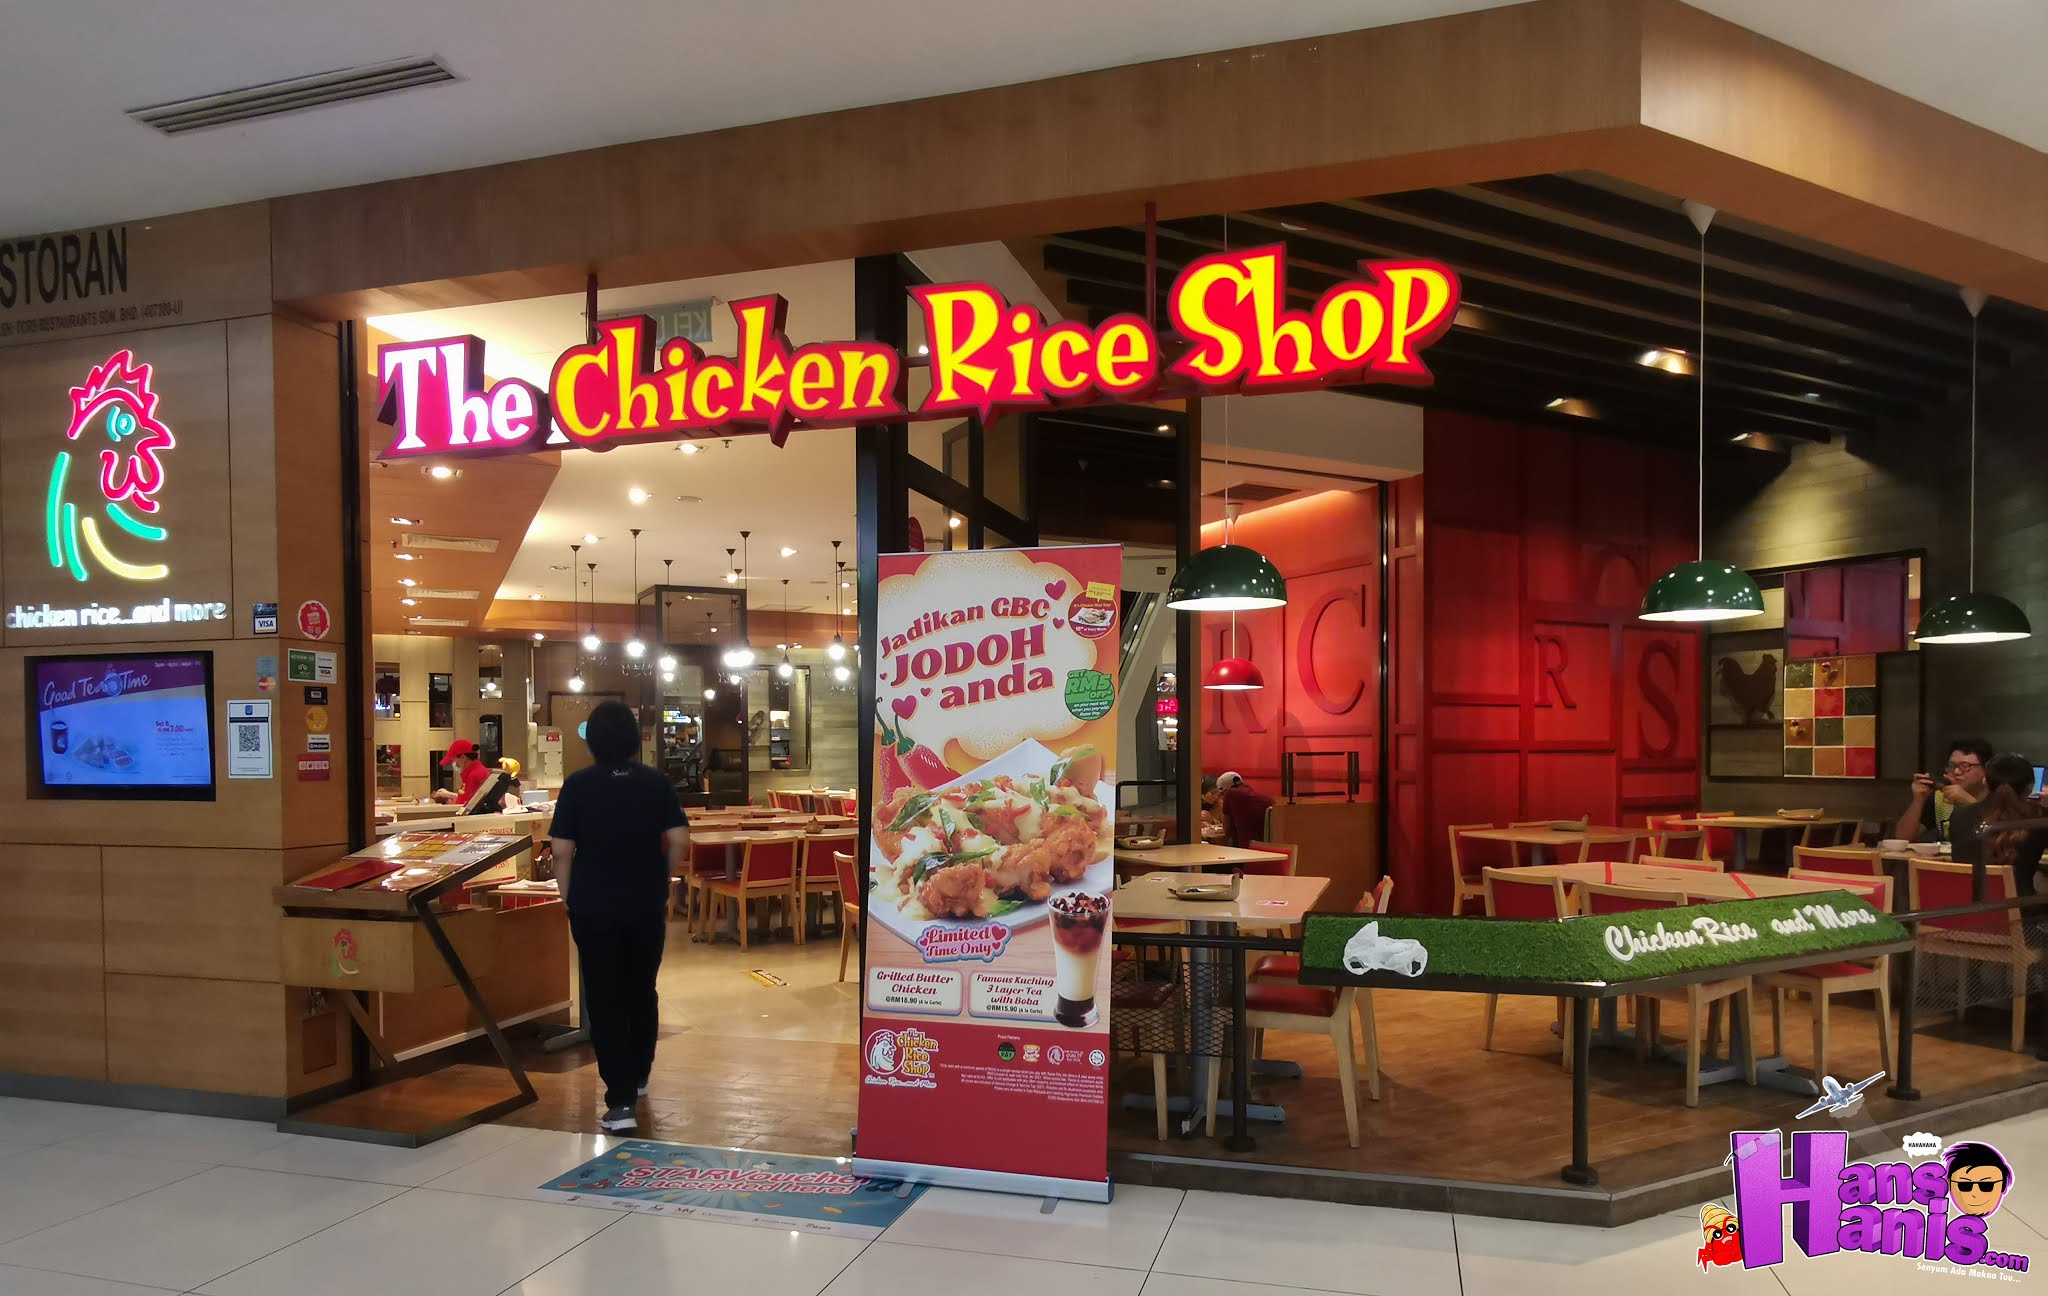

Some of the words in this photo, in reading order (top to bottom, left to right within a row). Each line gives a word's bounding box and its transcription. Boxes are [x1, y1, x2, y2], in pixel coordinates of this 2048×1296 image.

[0, 226, 127, 308] STORAN
[384, 342, 533, 450] The
[554, 305, 891, 438] Chicken
[925, 289, 1150, 402] Rice
[6, 603, 78, 628] chicken
[174, 602, 226, 622] more
[258, 620, 274, 628] VISA
[879, 602, 986, 660] Jadikan
[990, 596, 1052, 620] GBC
[890, 623, 1048, 688] JODOH
[43, 680, 77, 709] Good
[120, 669, 151, 690] Time
[938, 663, 1056, 711] anda
[1066, 674, 1112, 694] RM5
[926, 926, 992, 943] Limited
[1604, 922, 1705, 963] Chicken
[1692, 916, 1758, 946] Rice
[1771, 907, 1815, 934] and
[1804, 905, 1877, 930] More
[926, 944, 958, 957] Time
[960, 942, 991, 956] Only
[876, 971, 915, 982] Grilled
[916, 973, 954, 984] Butter
[976, 974, 1013, 984] Famous
[1014, 976, 1054, 988] Kuching
[891, 984, 938, 996] Chicken
[986, 984, 992, 993] 3
[994, 986, 1024, 996] Layer
[1026, 987, 1042, 996] Tea
[990, 996, 1012, 1004] with
[1014, 997, 1039, 1006] Boba
[896, 1032, 938, 1049] Chicken
[906, 1047, 928, 1061] Rice
[646, 1180, 776, 1192] accepted
[780, 1182, 858, 1194] here!
